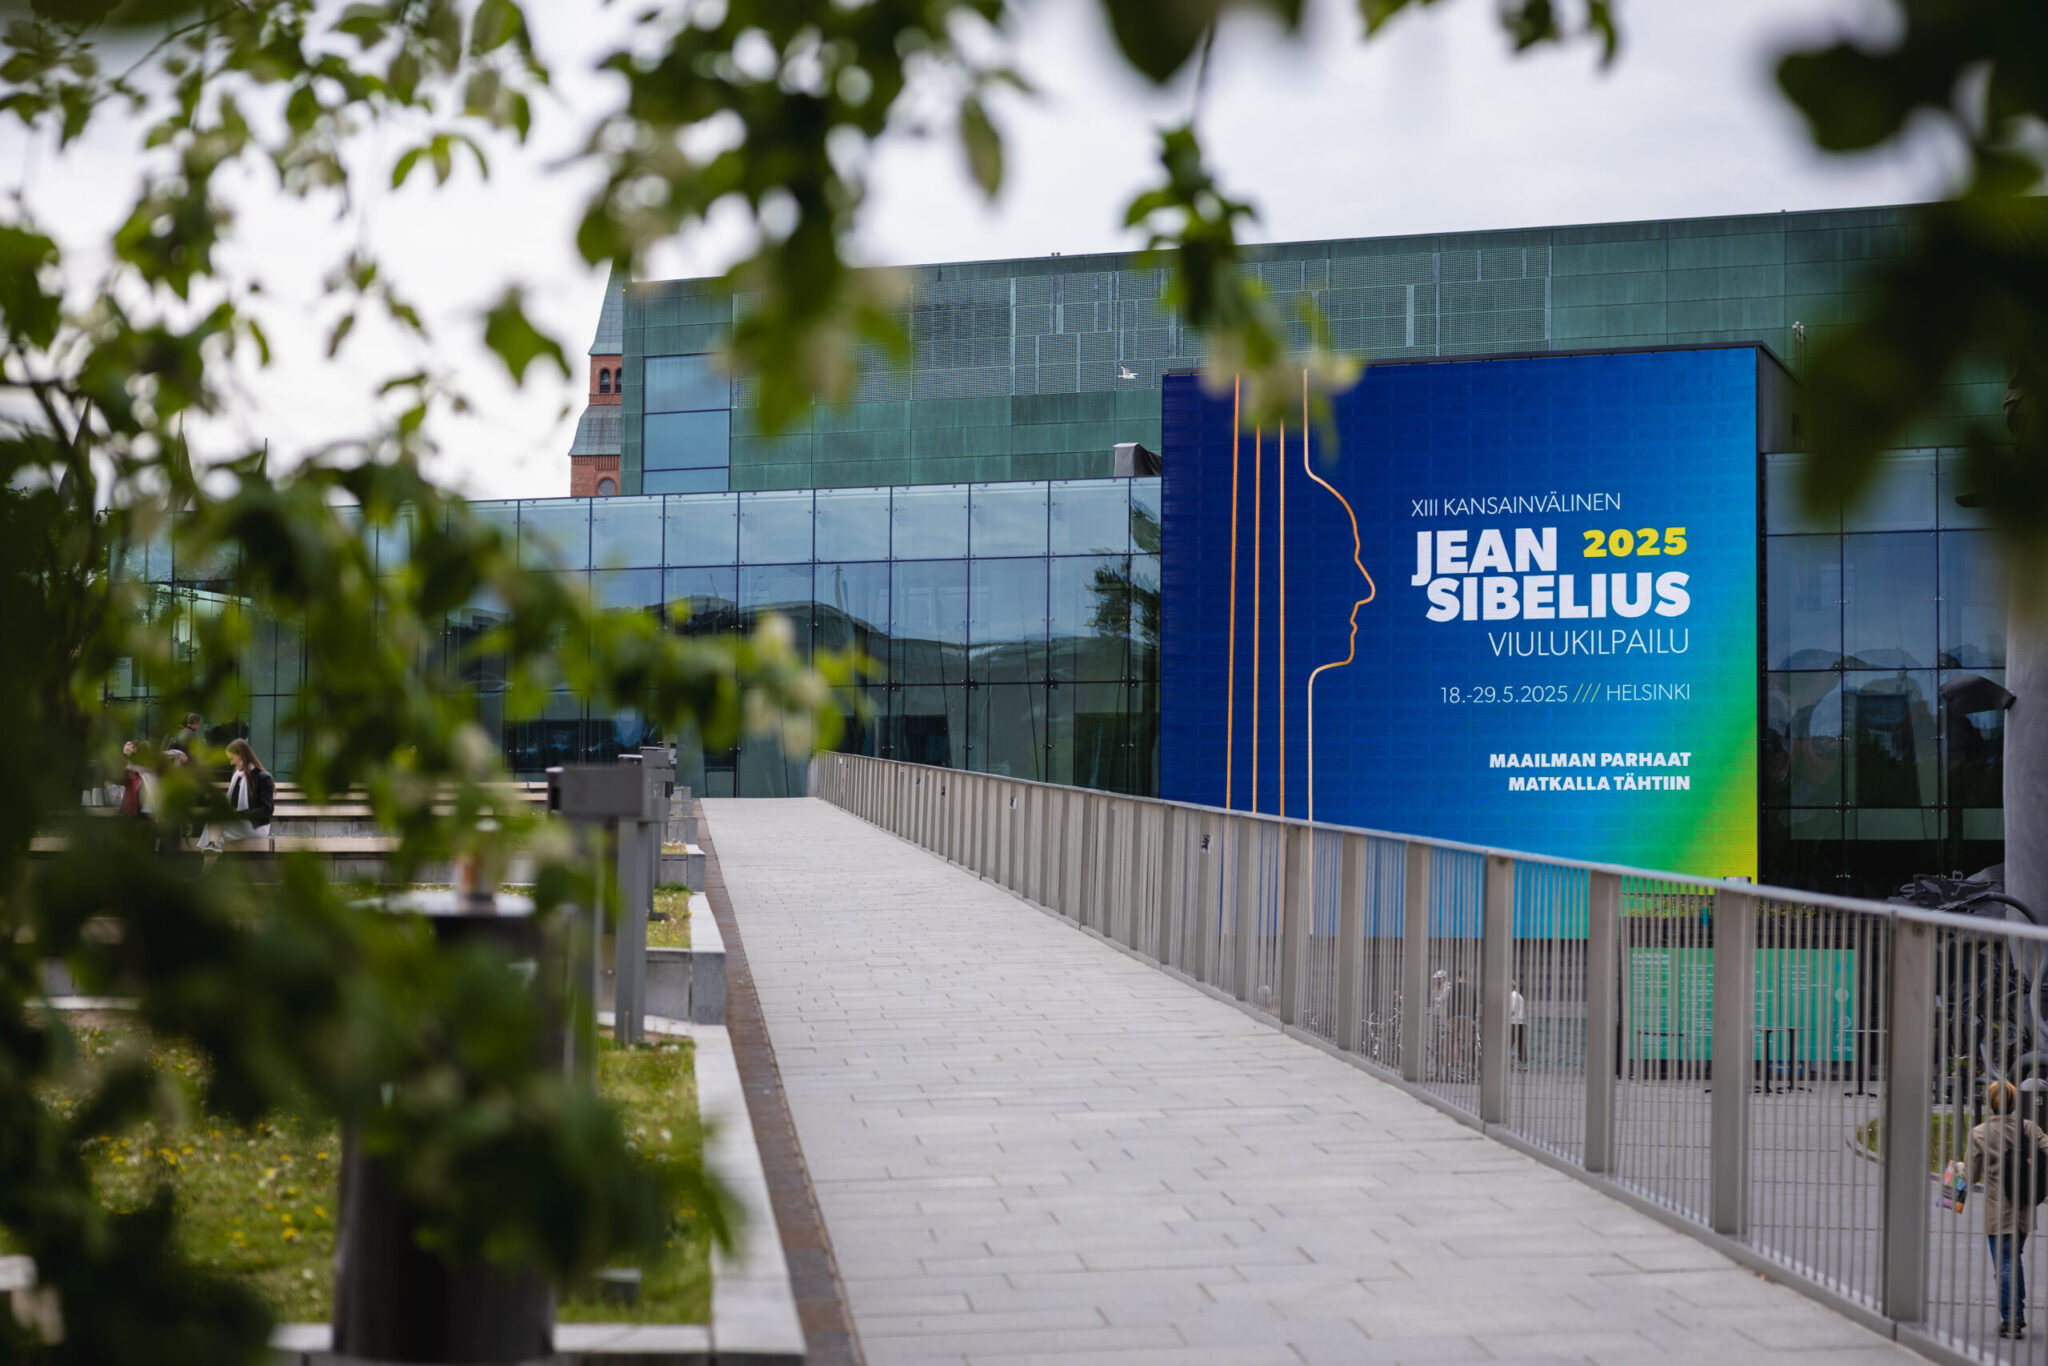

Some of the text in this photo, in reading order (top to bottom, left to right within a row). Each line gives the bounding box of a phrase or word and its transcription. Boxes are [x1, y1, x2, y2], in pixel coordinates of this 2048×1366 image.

[1411, 491, 1621, 517] XIII KANSAINVÄLINEN
[1411, 527, 1688, 586] JEAN 2025
[1425, 571, 1691, 622] SIBELIUS
[1488, 628, 1689, 657] VIULUKILPAILU
[1440, 685, 1568, 704] 18.-29.5.2025
[1606, 684, 1690, 701] HELSINKI
[1489, 752, 1691, 768] MAAILMAN PARHAAT
[1508, 773, 1690, 792] MATKALLA TÄHTIIN
